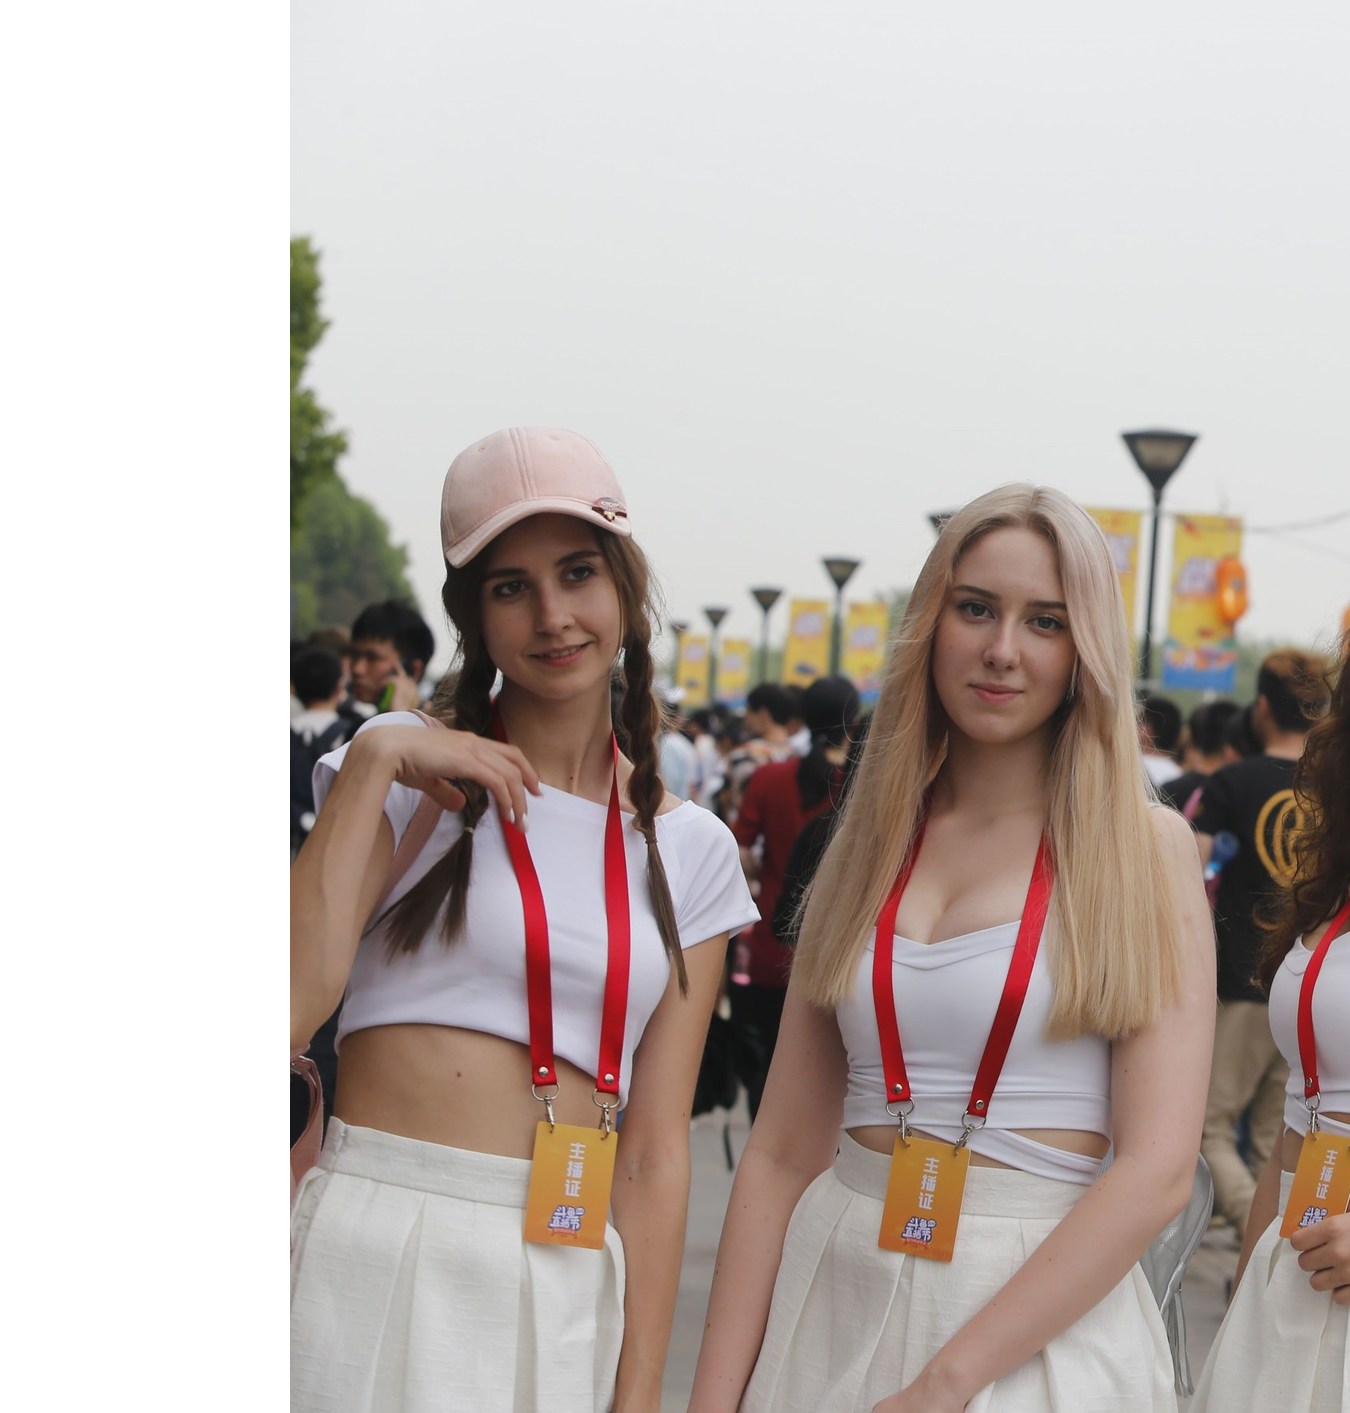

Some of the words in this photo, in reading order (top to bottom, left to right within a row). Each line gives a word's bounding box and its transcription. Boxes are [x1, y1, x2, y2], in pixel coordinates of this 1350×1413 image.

[565, 1142, 587, 1197] 主播证
[918, 1156, 940, 1210] 主播证
[1316, 1149, 1338, 1200] 主播证
